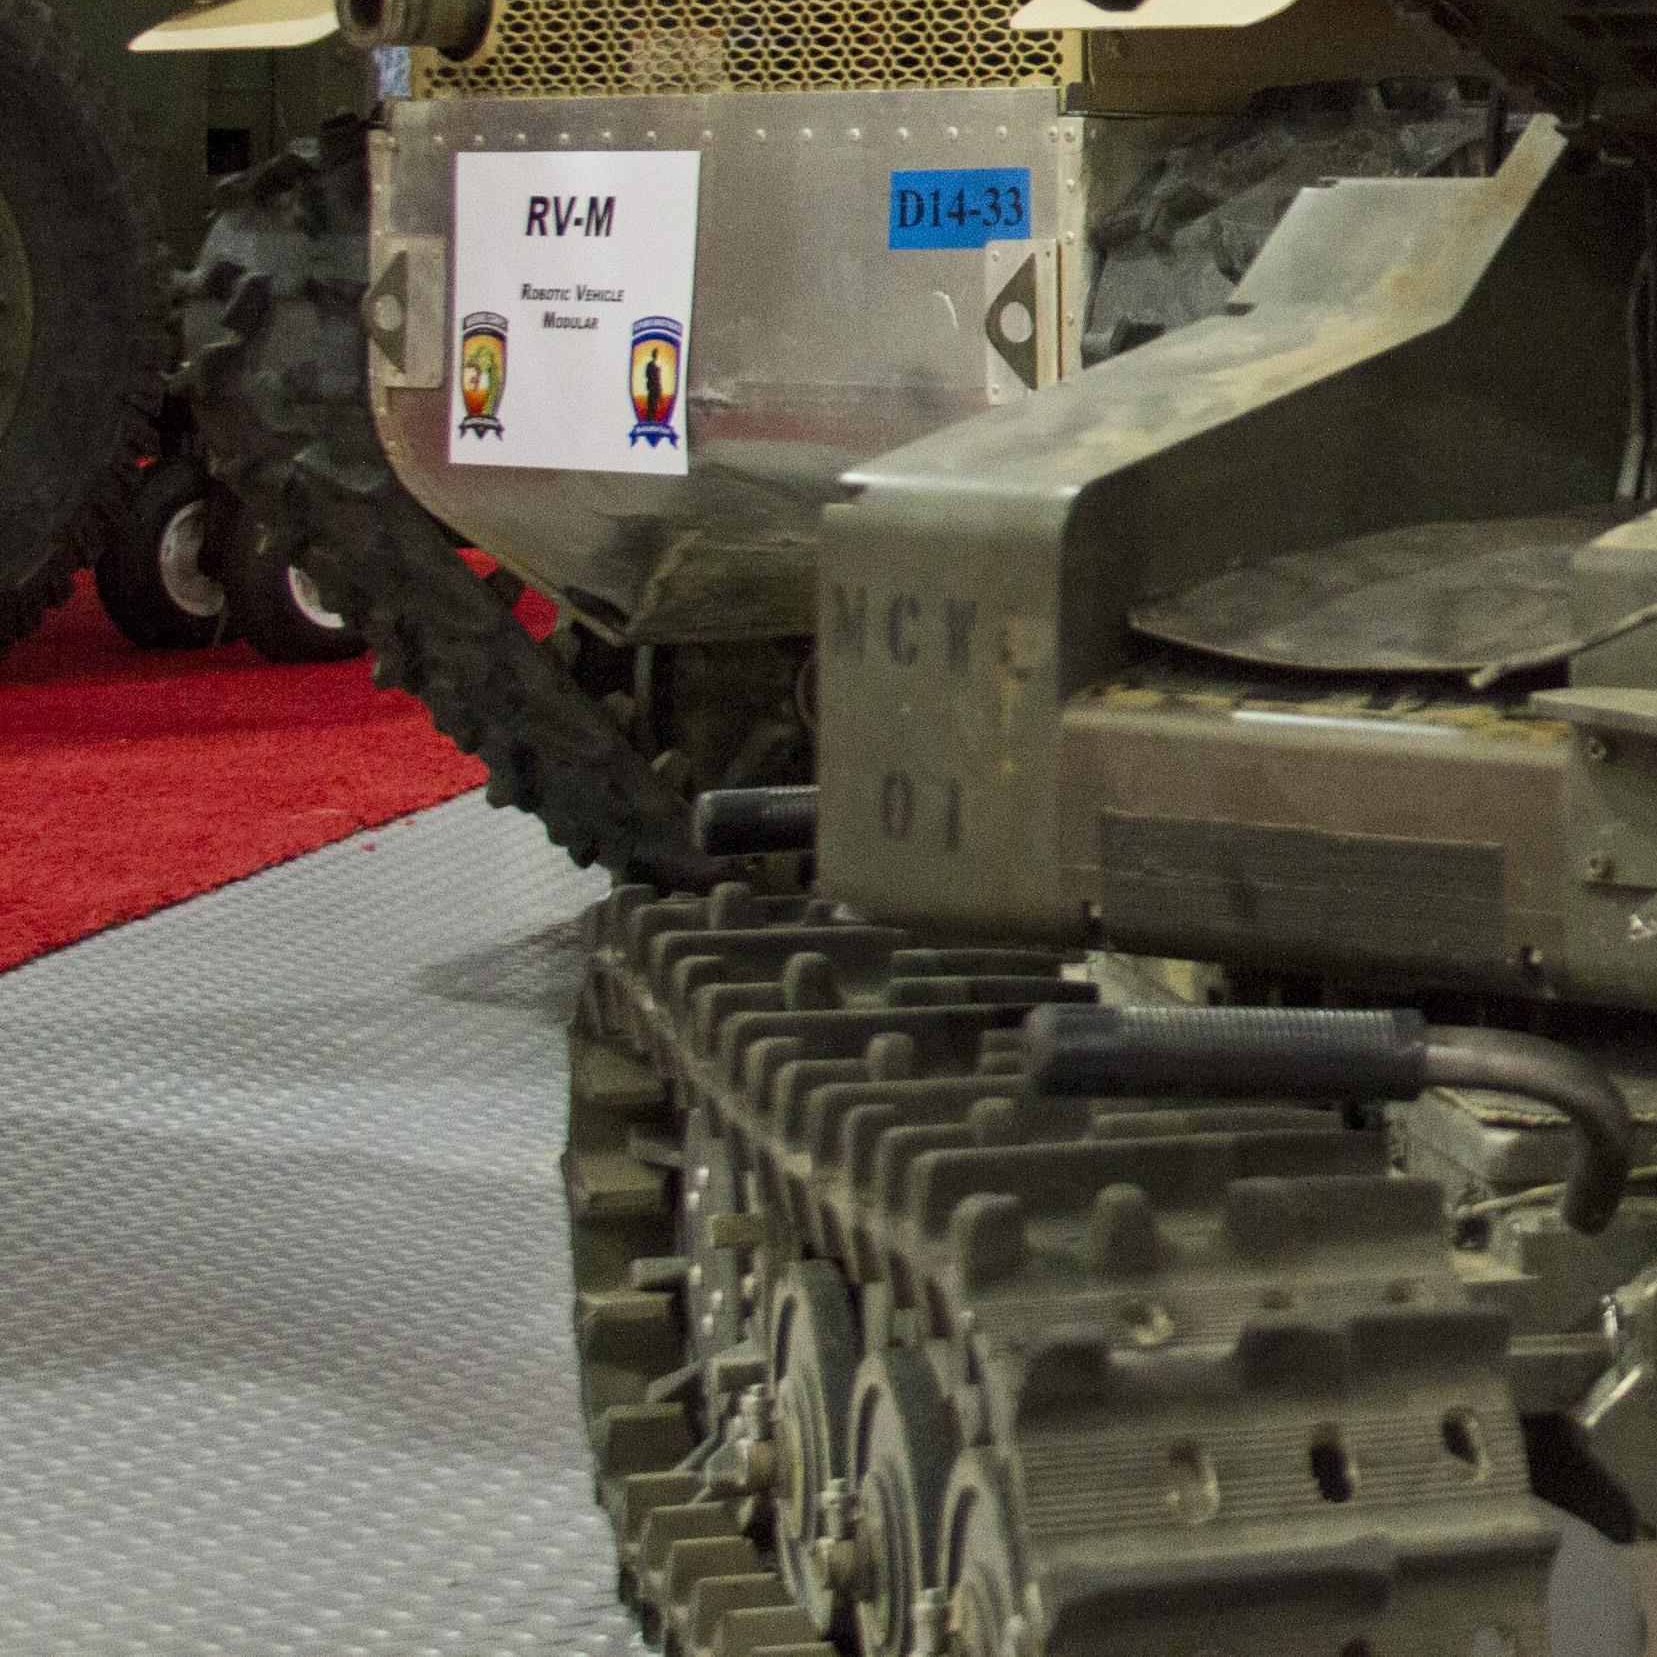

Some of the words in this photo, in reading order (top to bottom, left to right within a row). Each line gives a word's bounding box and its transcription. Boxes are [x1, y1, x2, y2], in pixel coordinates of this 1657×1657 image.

[525, 195, 617, 238] RV-M
[898, 184, 1025, 231] D14-33
[521, 283, 571, 302] ROBOTIC
[575, 283, 625, 303] VEHICLE
[542, 310, 600, 330] MODULAR
